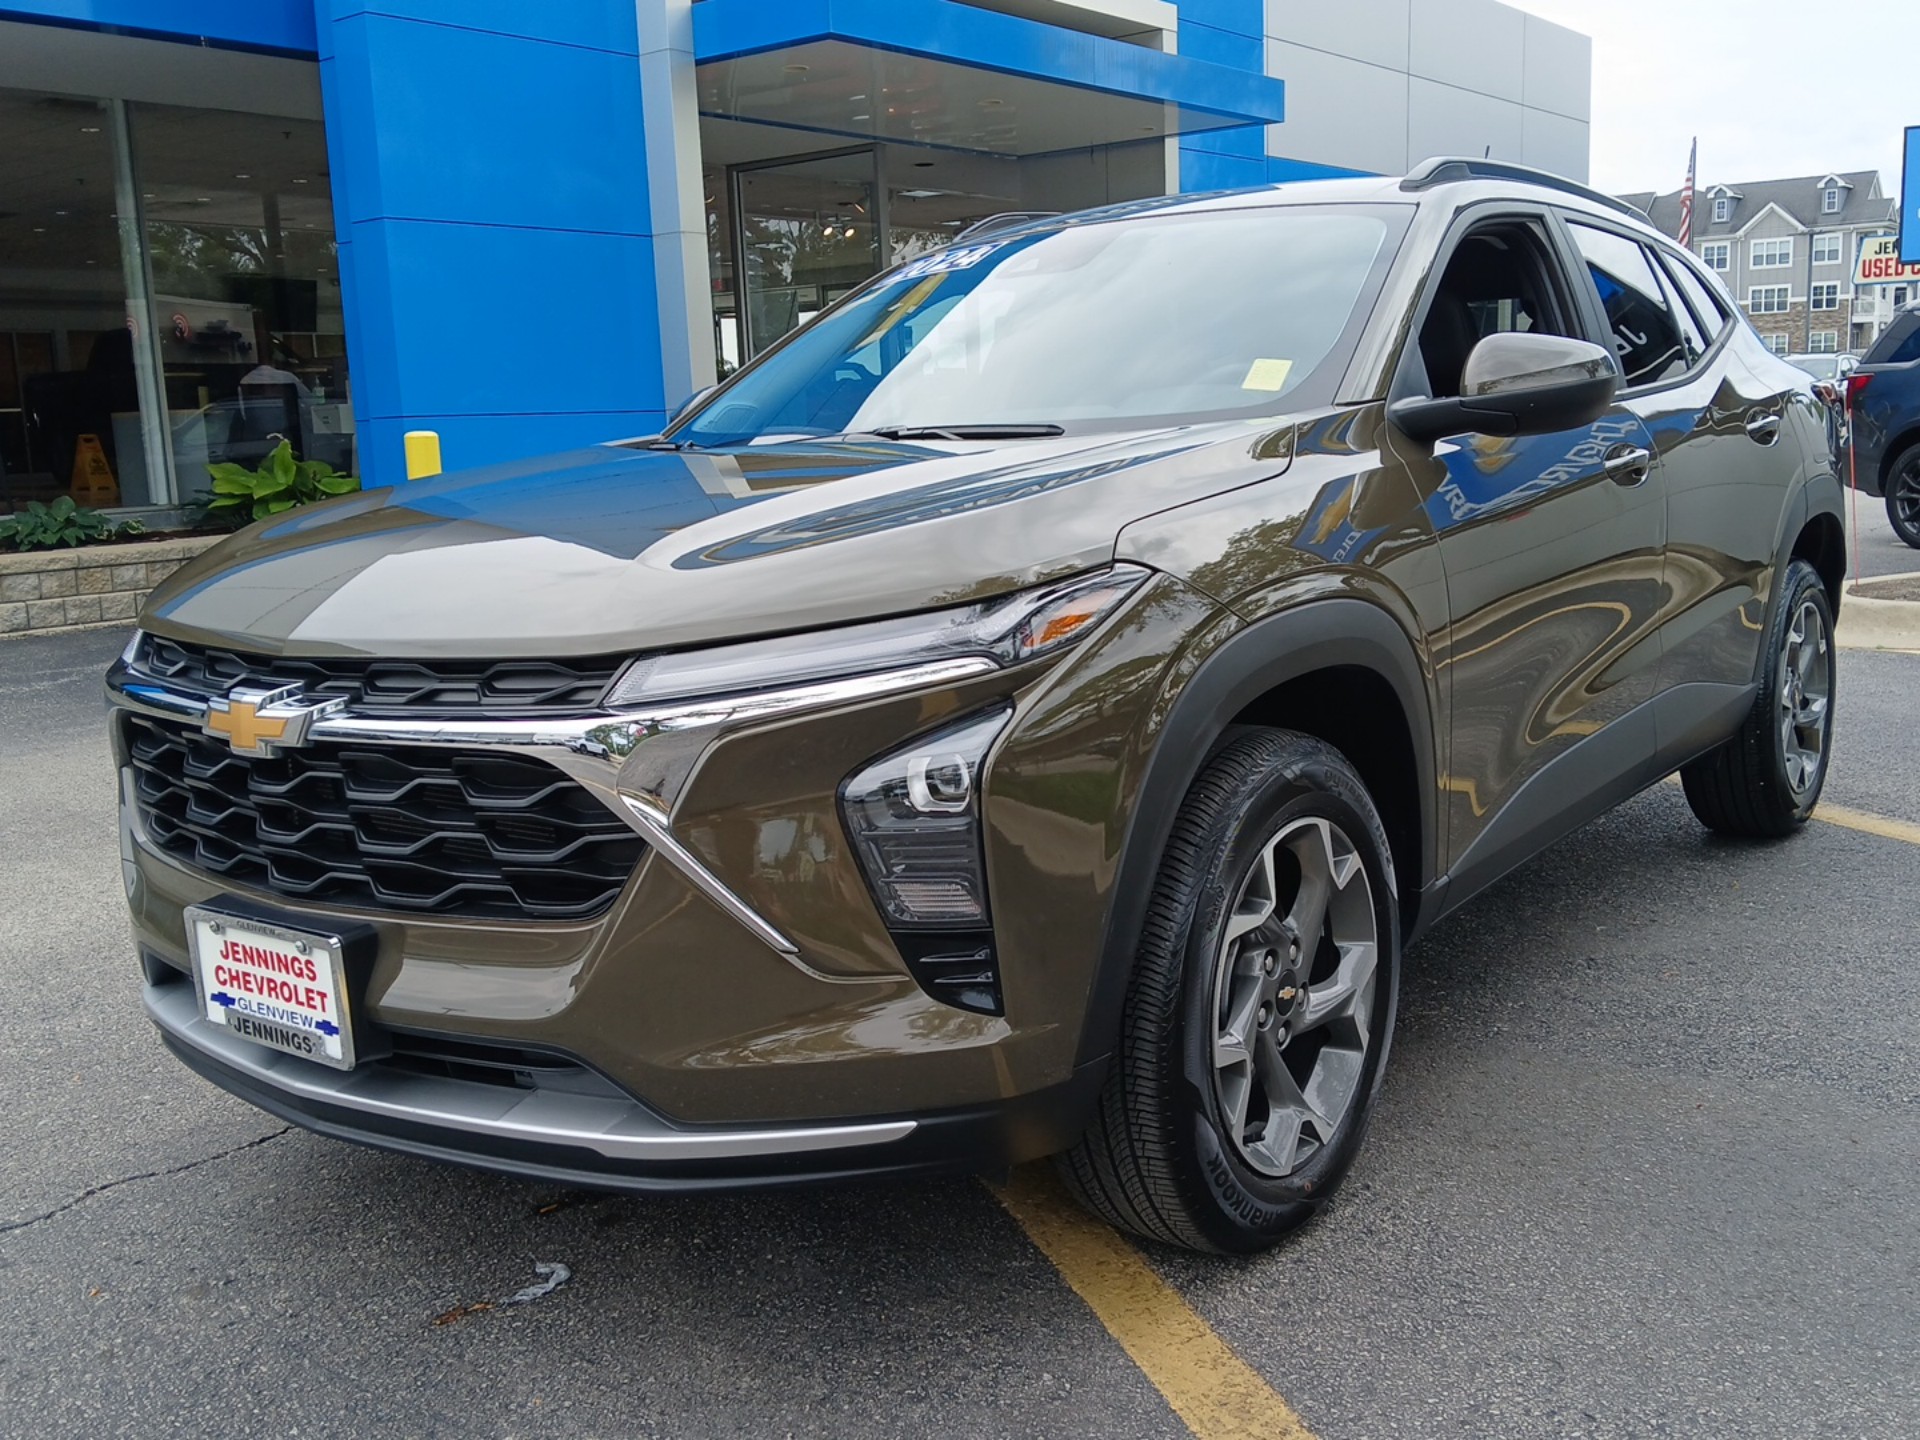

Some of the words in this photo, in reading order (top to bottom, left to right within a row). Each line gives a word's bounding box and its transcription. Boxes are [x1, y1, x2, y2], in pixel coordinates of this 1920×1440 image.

[1862, 257, 1905, 278] USED
[220, 940, 317, 982] JENNINGS
[215, 965, 327, 1013] CHEVROLET
[237, 997, 315, 1028] GLENVIEW
[234, 1017, 312, 1054] JENNINGS
